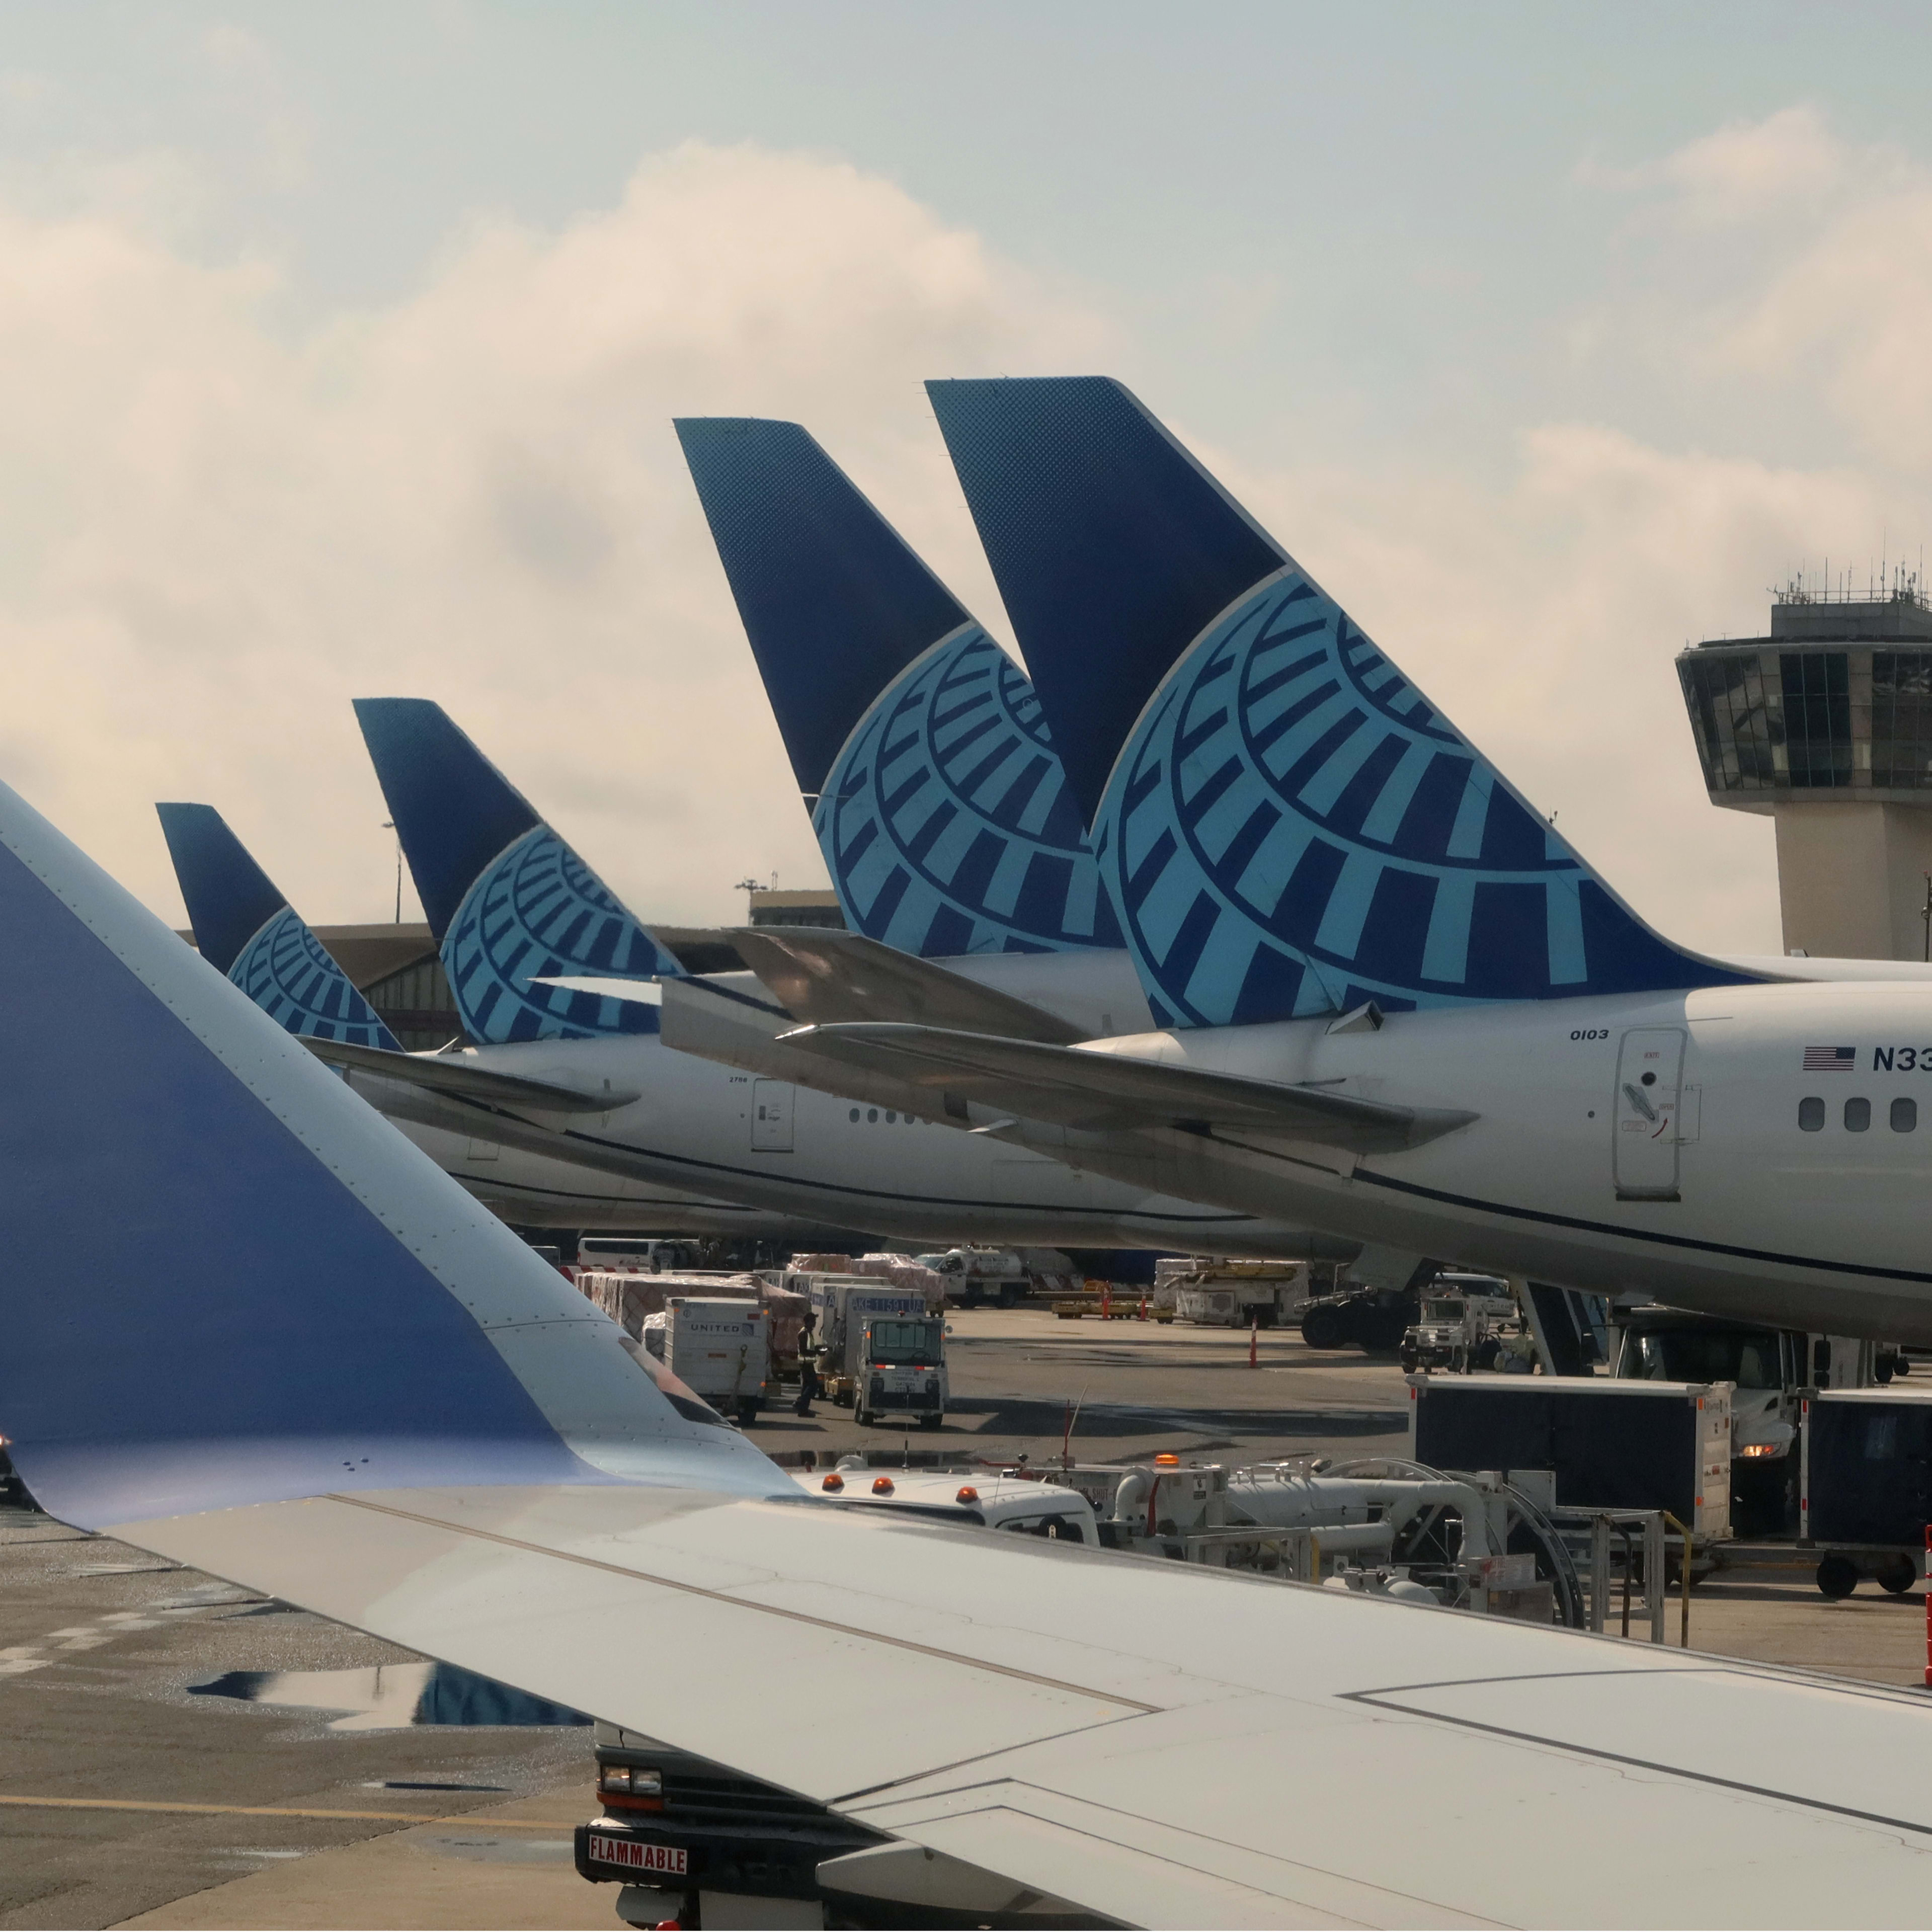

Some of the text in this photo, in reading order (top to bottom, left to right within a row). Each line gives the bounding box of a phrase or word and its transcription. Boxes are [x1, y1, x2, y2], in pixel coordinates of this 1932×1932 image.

[1570, 1029, 1609, 1040] 0103
[853, 1298, 870, 1310] AKE
[909, 1300, 923, 1313] UA
[691, 1324, 739, 1332] UNITED
[591, 1837, 685, 1872] FLAMMABLE
